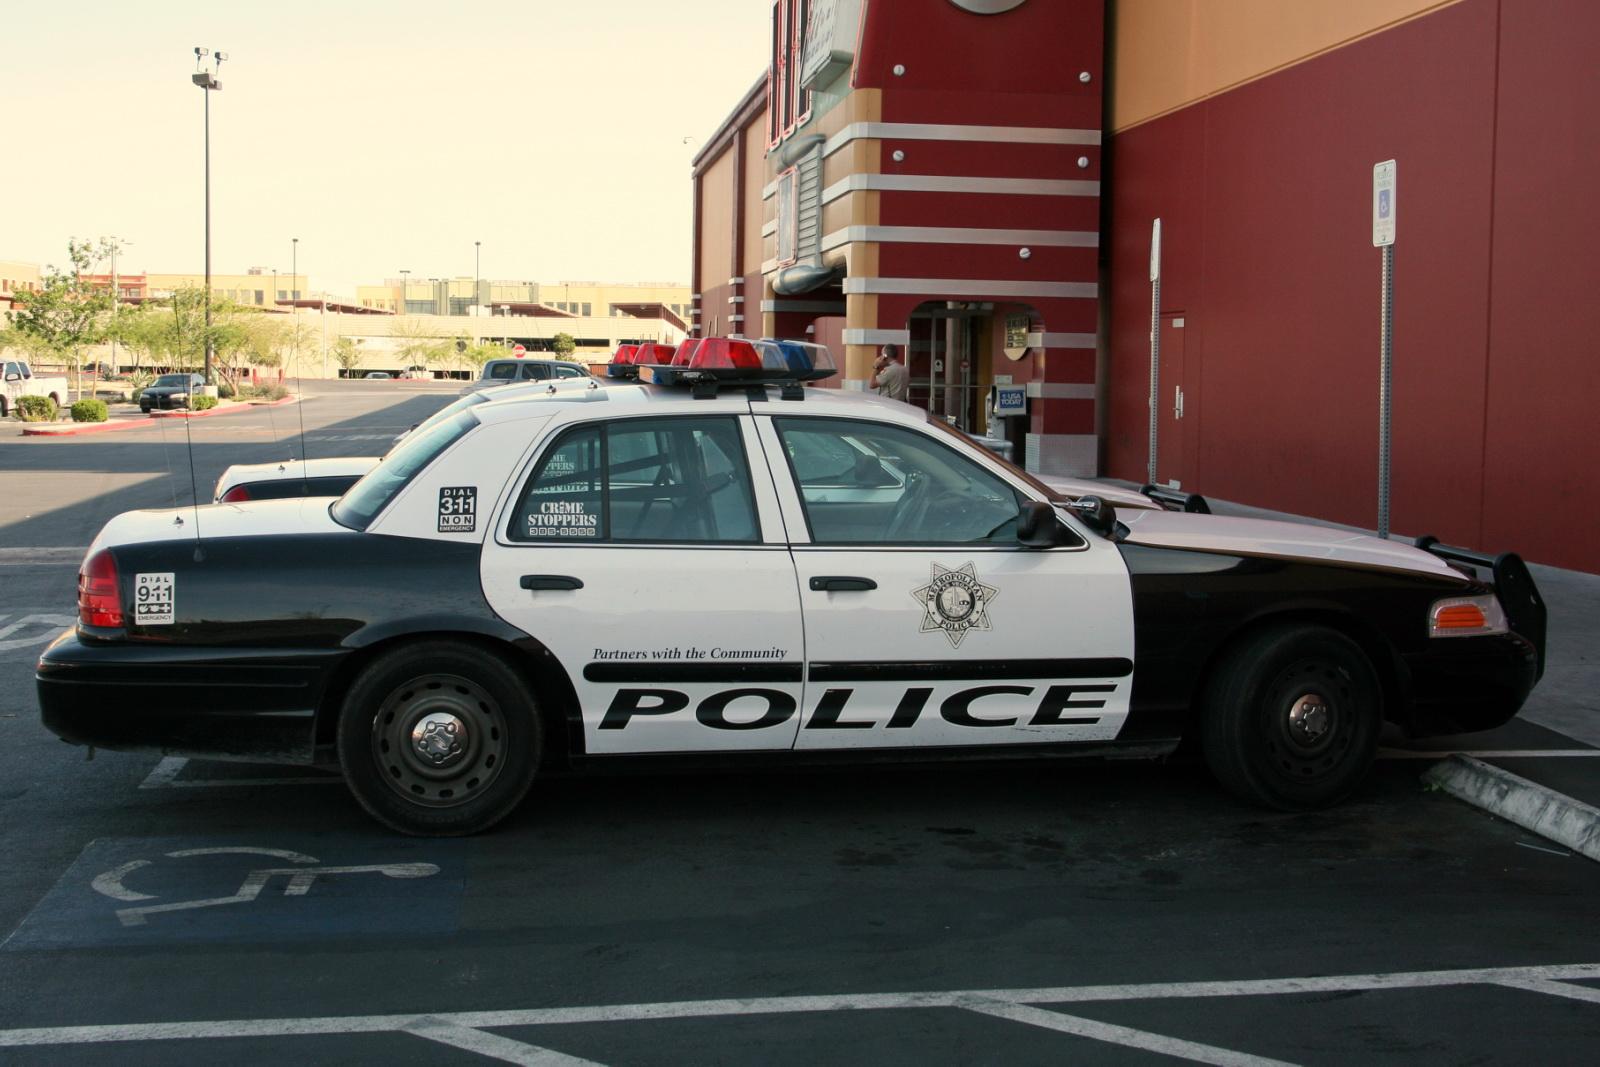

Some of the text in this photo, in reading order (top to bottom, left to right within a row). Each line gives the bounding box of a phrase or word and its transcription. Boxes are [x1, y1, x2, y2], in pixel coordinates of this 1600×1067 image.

[444, 488, 472, 496] DIAL
[442, 516, 472, 524] NON
[528, 514, 597, 526] STOPPERS
[928, 573, 983, 602] METROPOLITAN
[940, 618, 974, 630] POLICE
[592, 646, 787, 661] Partners with the Community
[597, 684, 1118, 730] POLICE
